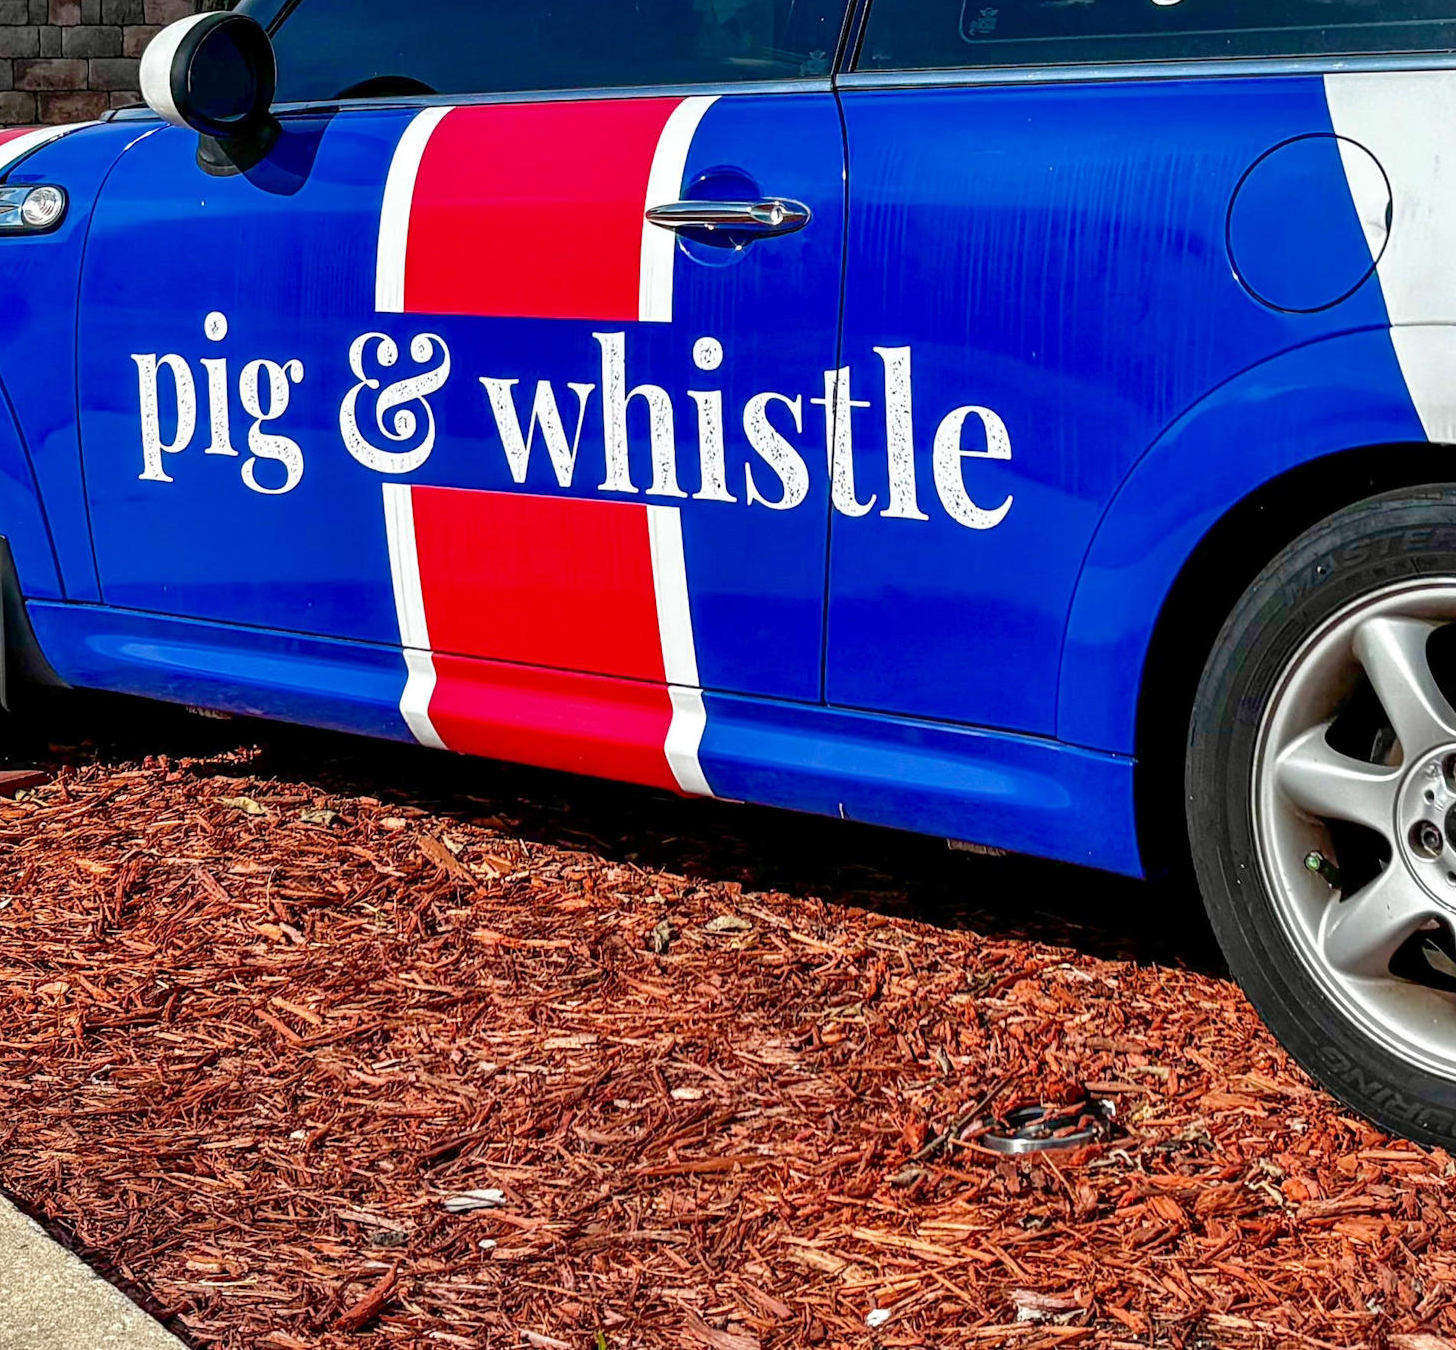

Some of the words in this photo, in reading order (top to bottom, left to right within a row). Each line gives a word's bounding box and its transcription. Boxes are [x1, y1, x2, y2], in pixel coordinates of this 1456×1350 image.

[131, 310, 304, 496] pig
[340, 332, 451, 475] &
[479, 332, 1014, 531] whistle
